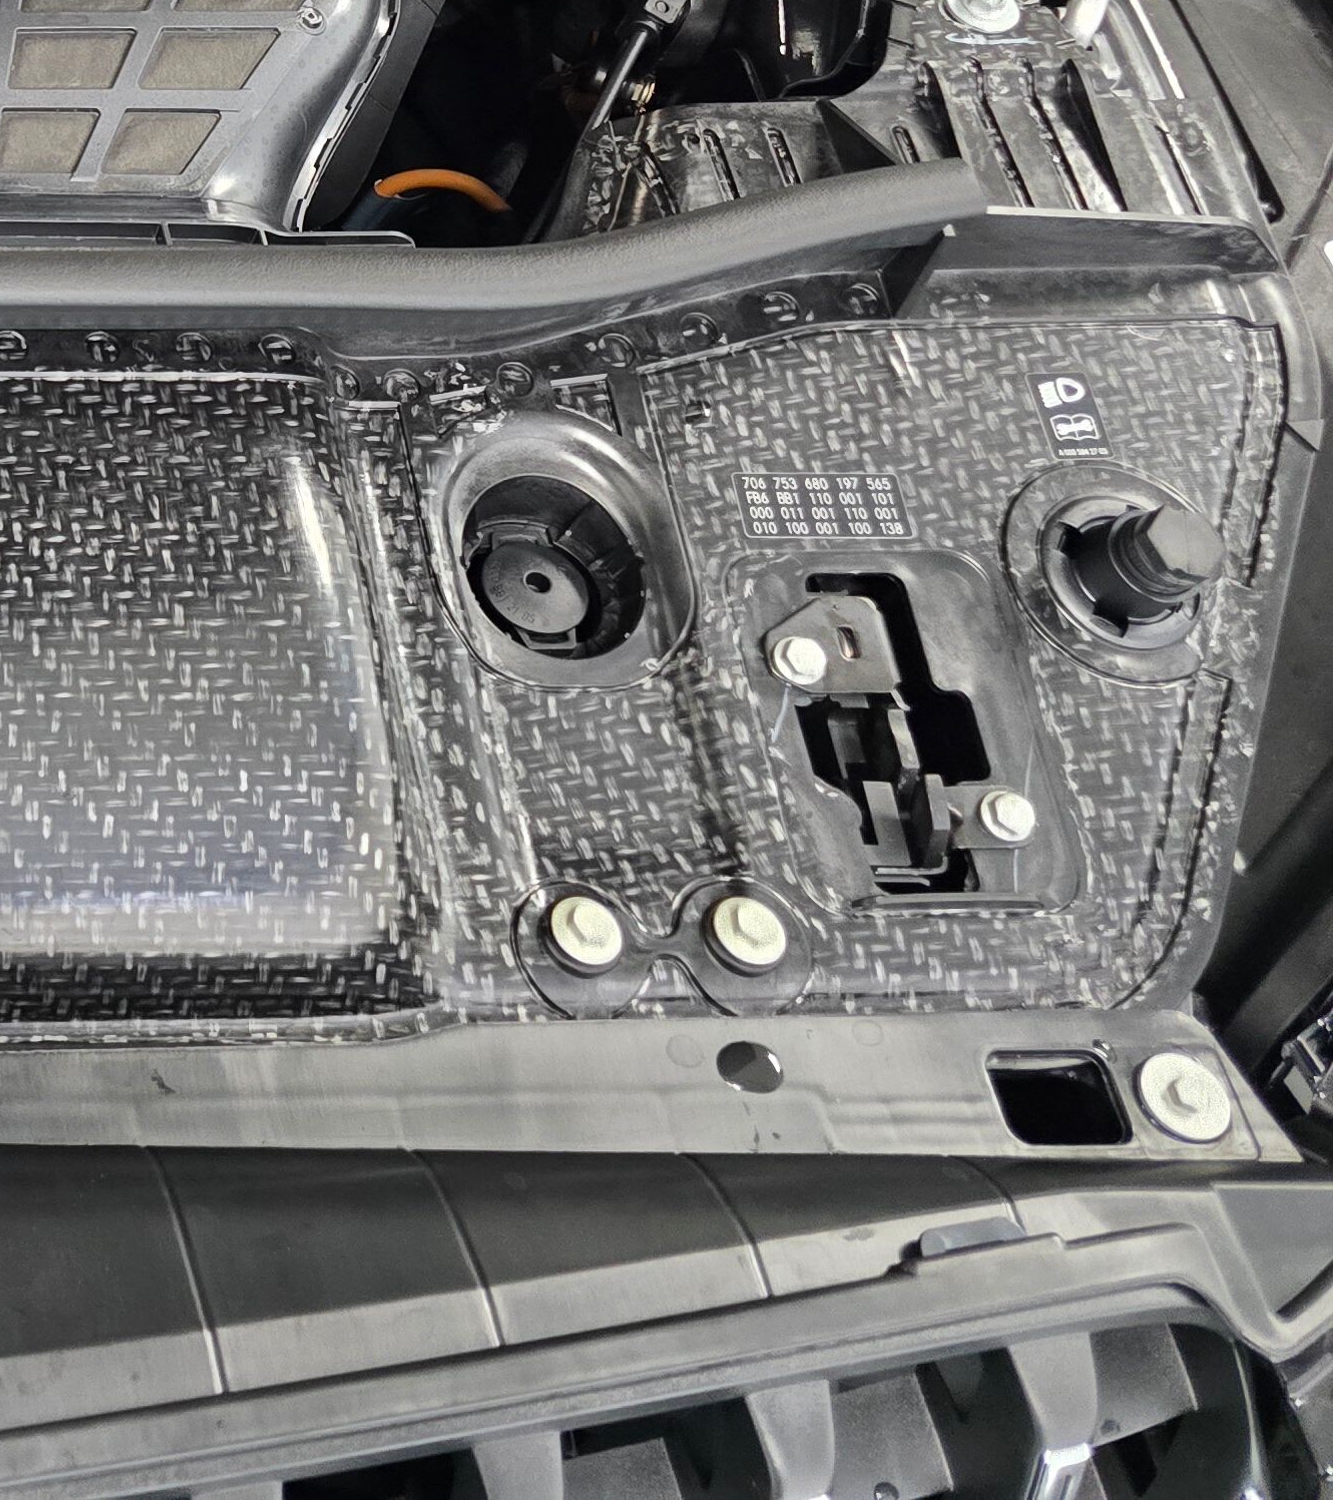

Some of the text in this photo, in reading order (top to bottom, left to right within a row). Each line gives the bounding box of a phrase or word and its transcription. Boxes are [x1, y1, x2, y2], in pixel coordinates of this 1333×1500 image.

[742, 477, 891, 490] 706 753 680 197 565
[746, 492, 893, 505] FB6 BB1 110 001 101
[749, 507, 898, 520] 000 011 001 110 001
[753, 522, 903, 535] 010 100 001 100 138
